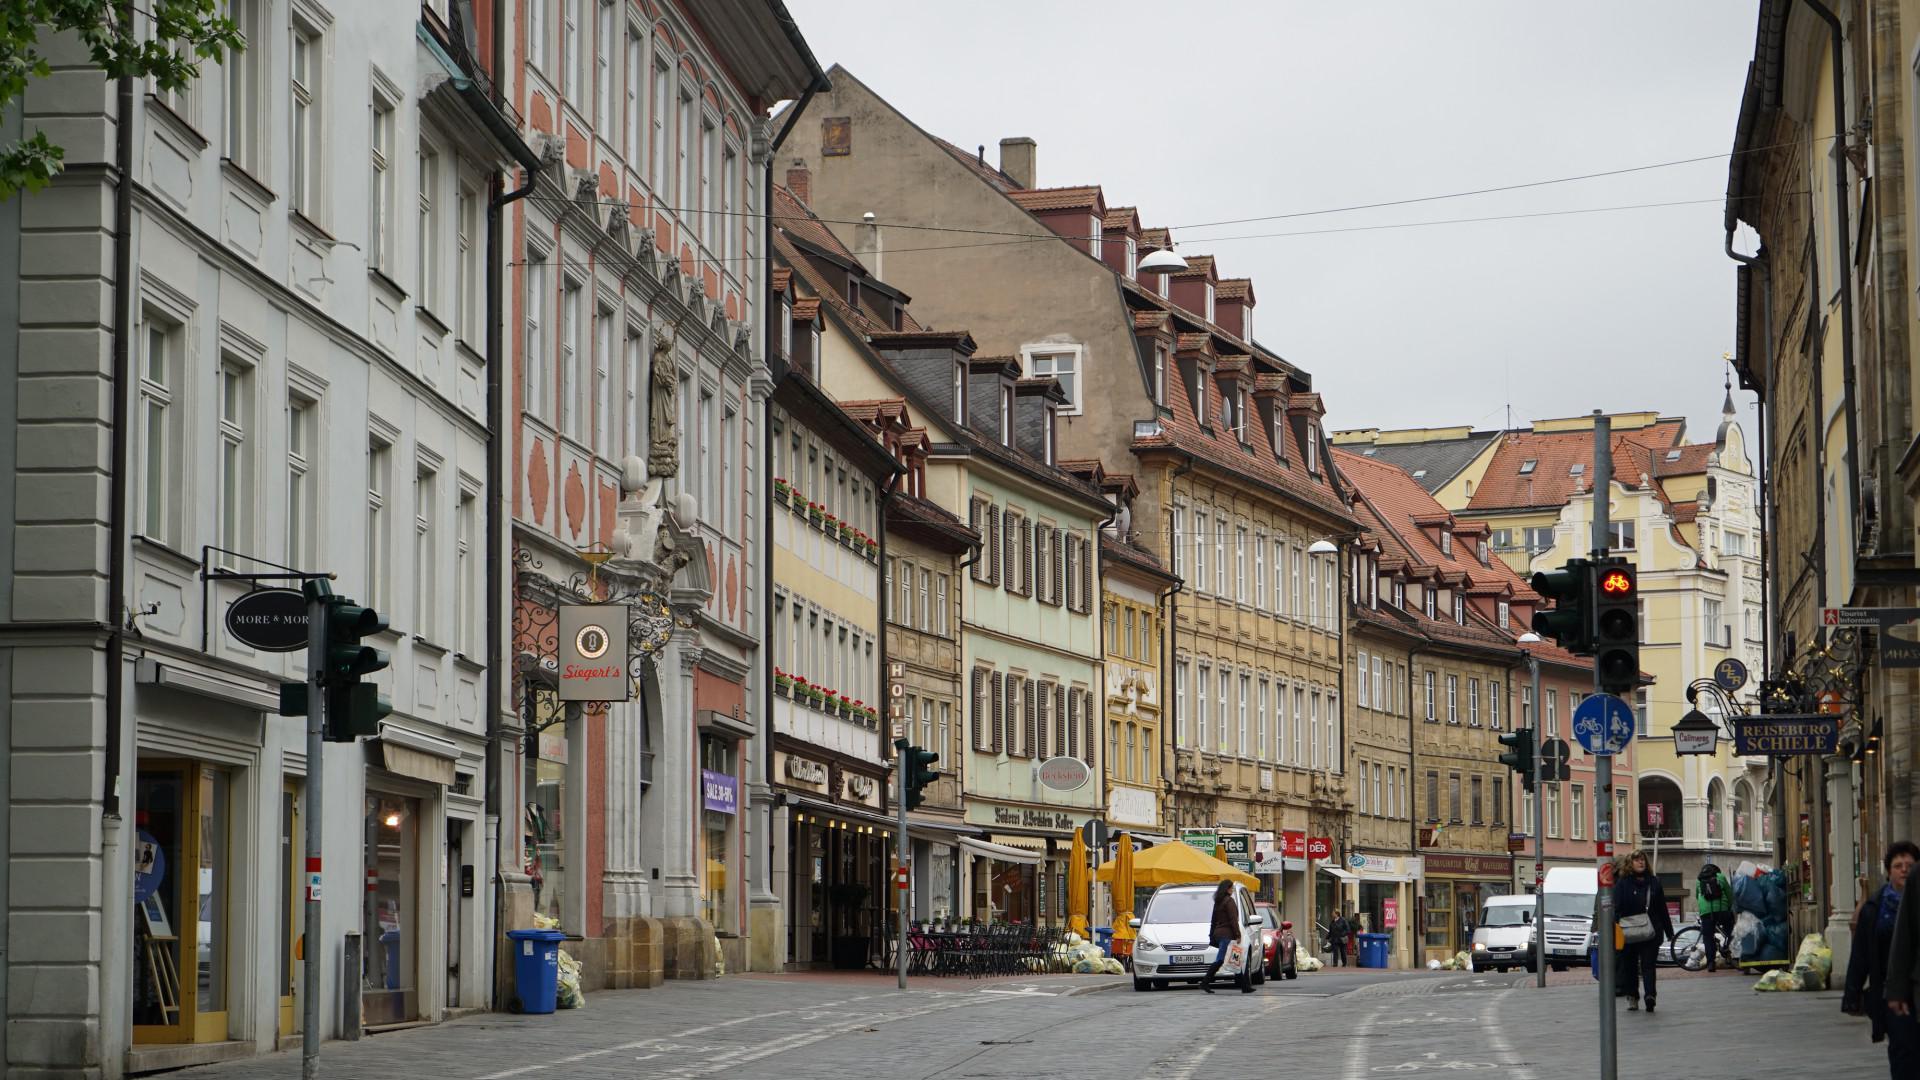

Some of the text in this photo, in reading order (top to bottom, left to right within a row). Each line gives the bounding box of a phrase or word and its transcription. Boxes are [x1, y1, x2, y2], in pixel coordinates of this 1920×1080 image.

[236, 615, 270, 624] MORE
[283, 615, 309, 624] MOR
[1720, 663, 1742, 685] DER
[1747, 736, 1827, 751] SCHIELE
[706, 782, 718, 800] SALE
[1222, 838, 1244, 852] Tee
[1309, 844, 1327, 853] DER
